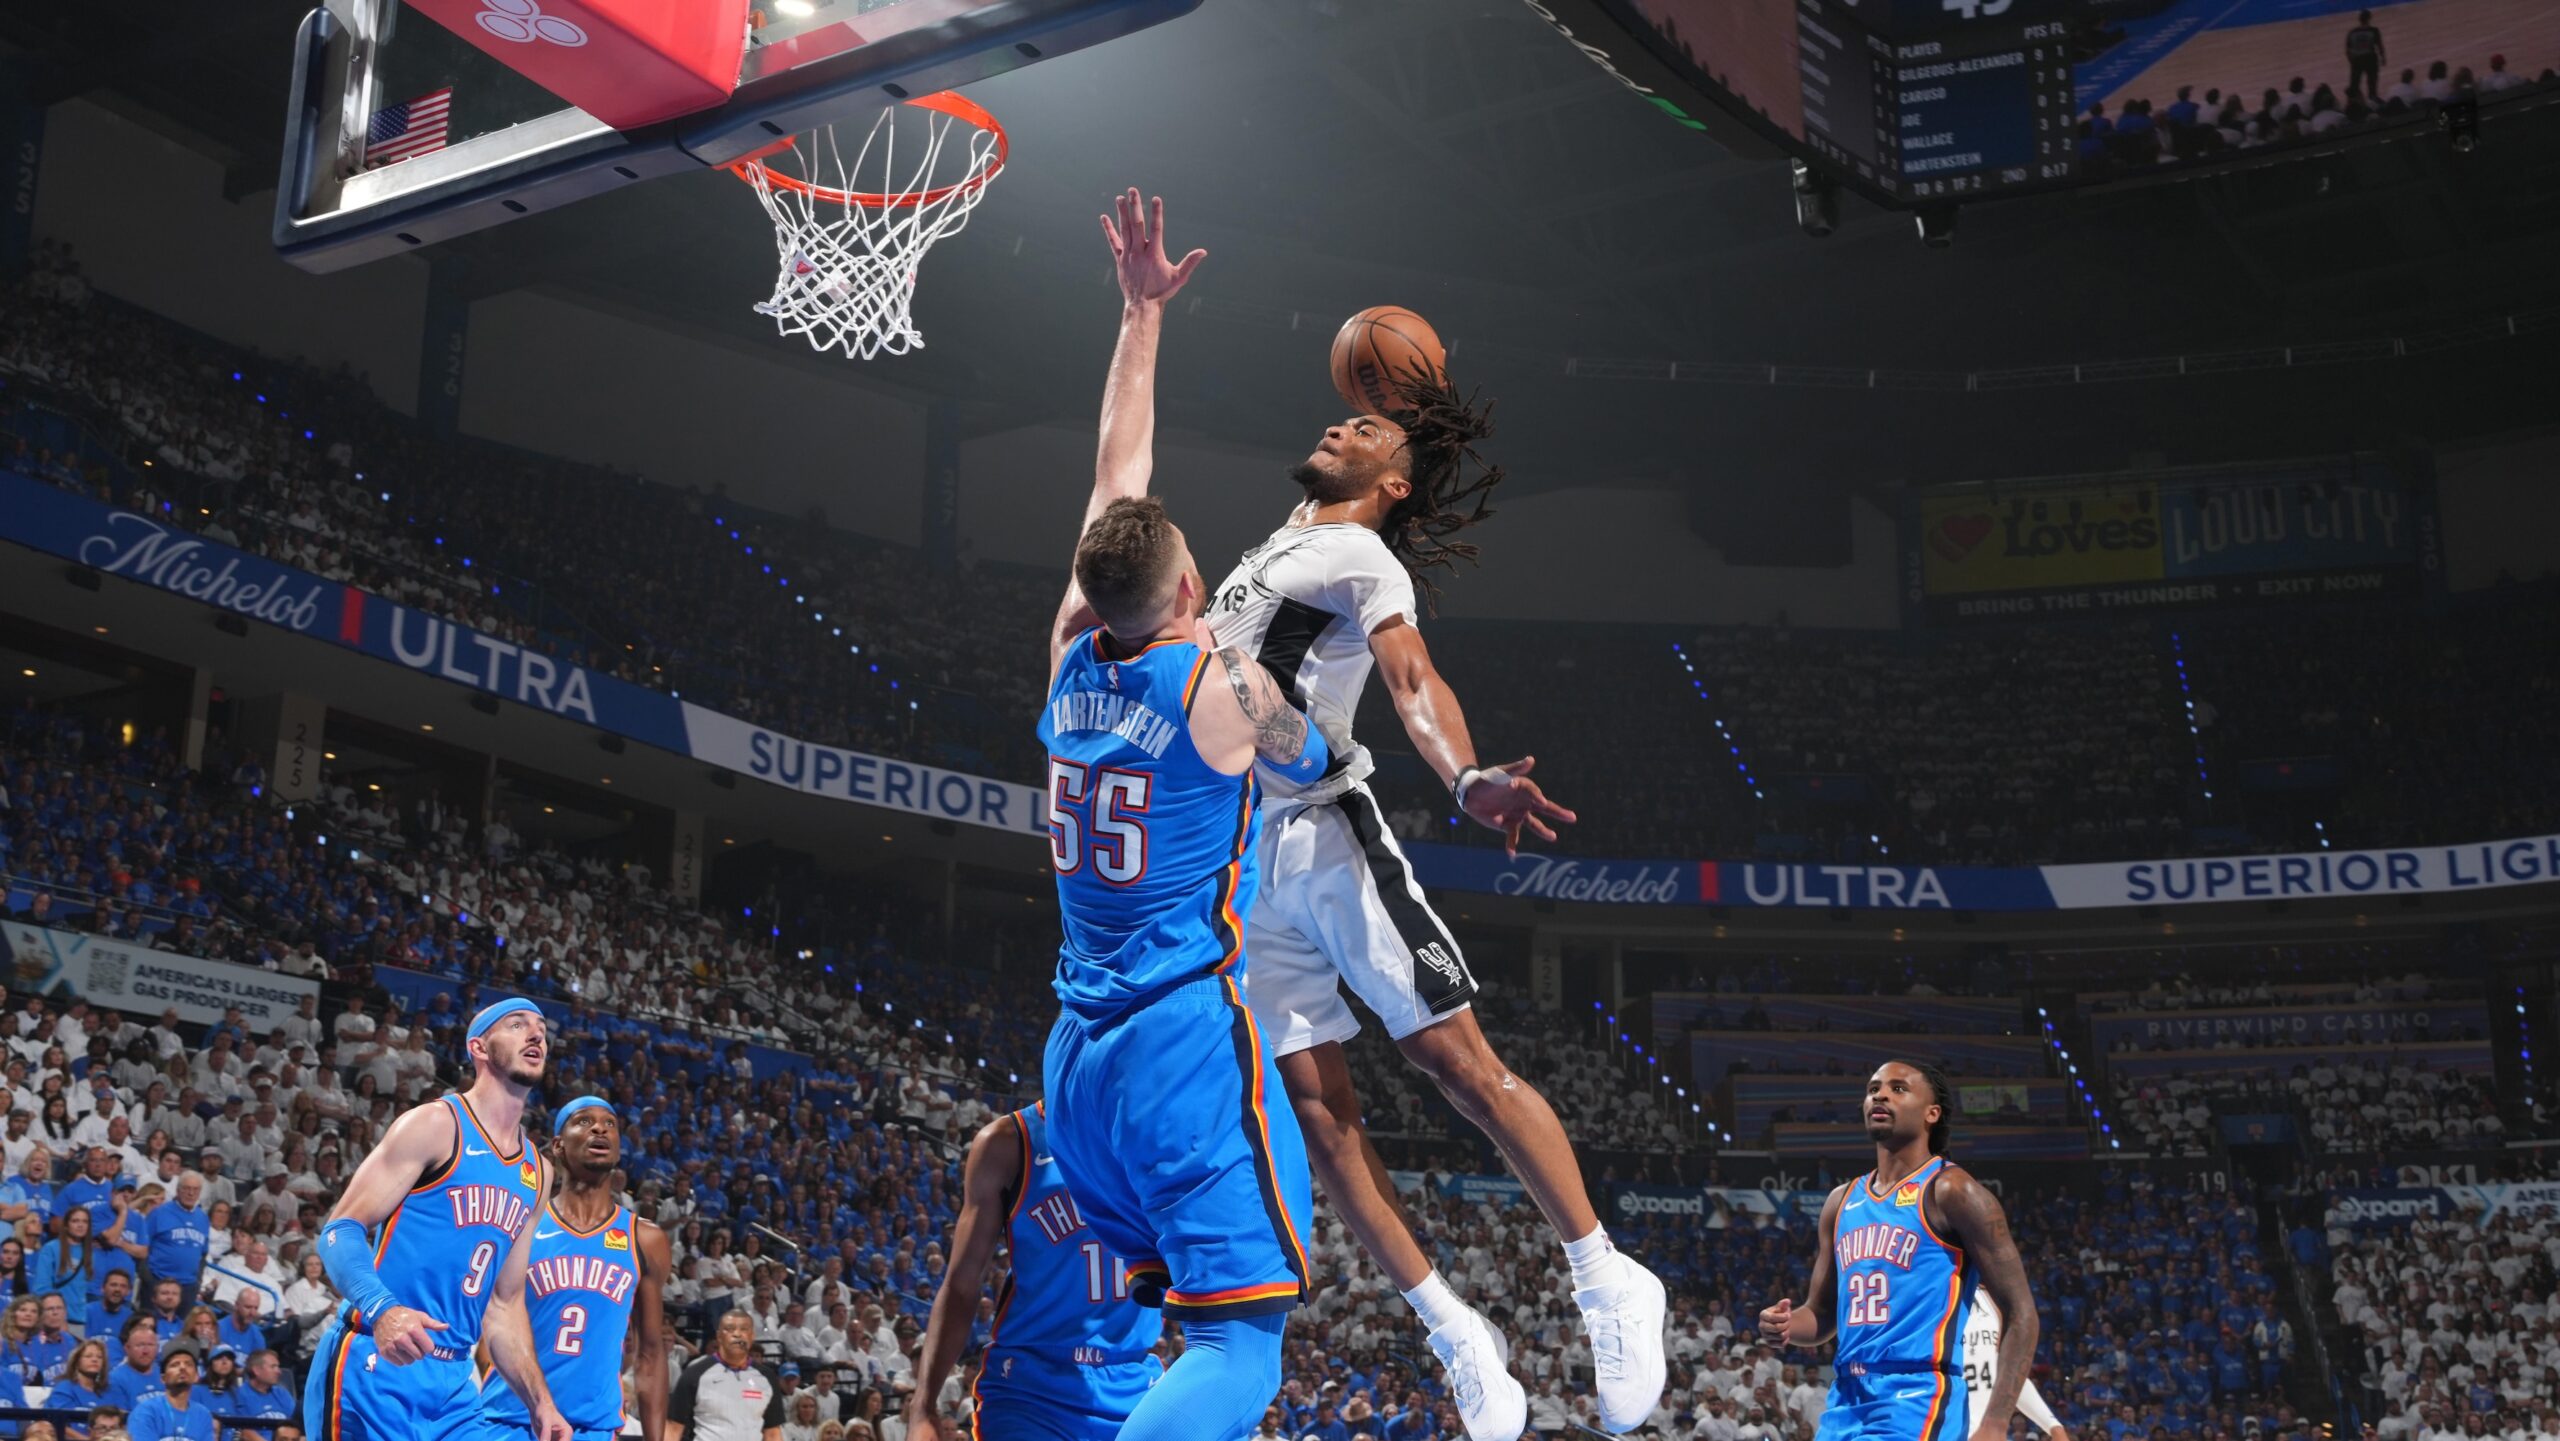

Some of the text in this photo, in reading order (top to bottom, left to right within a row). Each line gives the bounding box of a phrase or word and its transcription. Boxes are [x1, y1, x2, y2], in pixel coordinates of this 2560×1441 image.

[1898, 42, 1942, 59] PLAYER
[2024, 24, 2048, 40] PTS
[1898, 51, 2025, 82] GILGEOUS-ALEXANDER
[1900, 87, 1947, 105] CARUSO
[1901, 113, 1922, 128] JOE
[1903, 132, 1954, 150] WALLACE
[14, 142, 34, 214] 325
[1904, 152, 1982, 173] HARTENSTEIN
[2173, 484, 2399, 564] LOUD CITY
[2421, 516, 2439, 570] 330
[79, 511, 320, 631] Michelob
[1958, 573, 2384, 616] BRING THE THUNDER EXIT NOW
[389, 605, 597, 724] ULTRA
[295, 723, 307, 787] 225
[749, 732, 1007, 826] SUPERIOR
[1050, 756, 1153, 889] 55
[1494, 852, 1680, 903] Michelob
[1743, 864, 1953, 909] ULTRA
[2126, 853, 2421, 901] SUPERIOR
[133, 982, 271, 1018] GAS PRODUCER
[135, 964, 231, 993] AMERICA'S
[2147, 1012, 2431, 1037] RIVERWIND CASINO
[449, 1186, 531, 1242] THUNDE
[1618, 1191, 1704, 1219] expand
[2339, 1195, 2440, 1222] expand
[463, 1242, 496, 1296] 9
[1080, 1240, 1129, 1303] 11
[1836, 1224, 1920, 1272] THUNDER
[526, 1256, 633, 1304] THUNDER
[1848, 1271, 1889, 1325] 22
[555, 1305, 586, 1356] 2
[1961, 1330, 1999, 1348] URS
[1963, 1360, 1992, 1393] 24
